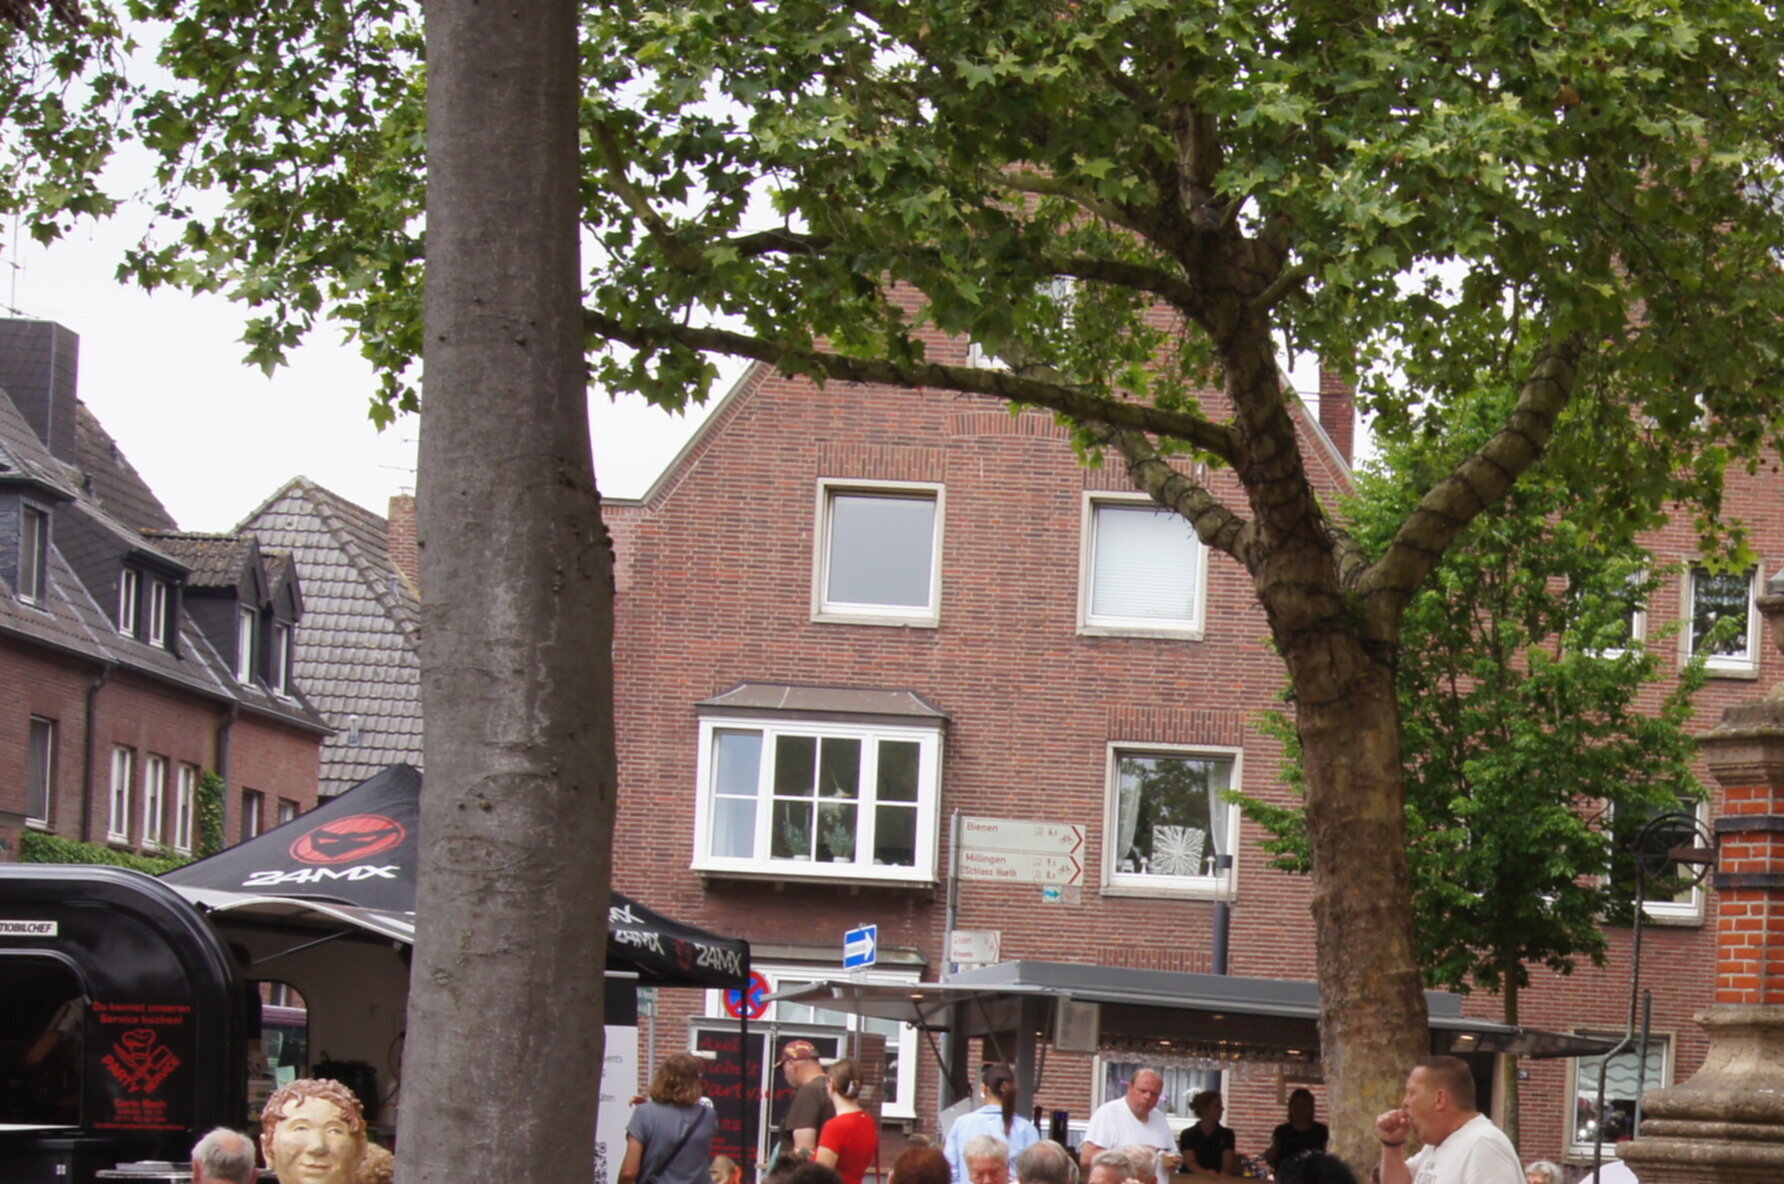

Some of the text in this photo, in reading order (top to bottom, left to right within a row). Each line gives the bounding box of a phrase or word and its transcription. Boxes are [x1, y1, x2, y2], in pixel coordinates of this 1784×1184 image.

[966, 821, 999, 832] Bienen
[965, 852, 1007, 864] Millingen
[242, 864, 402, 886] 24MX
[694, 942, 742, 977] 24MX
